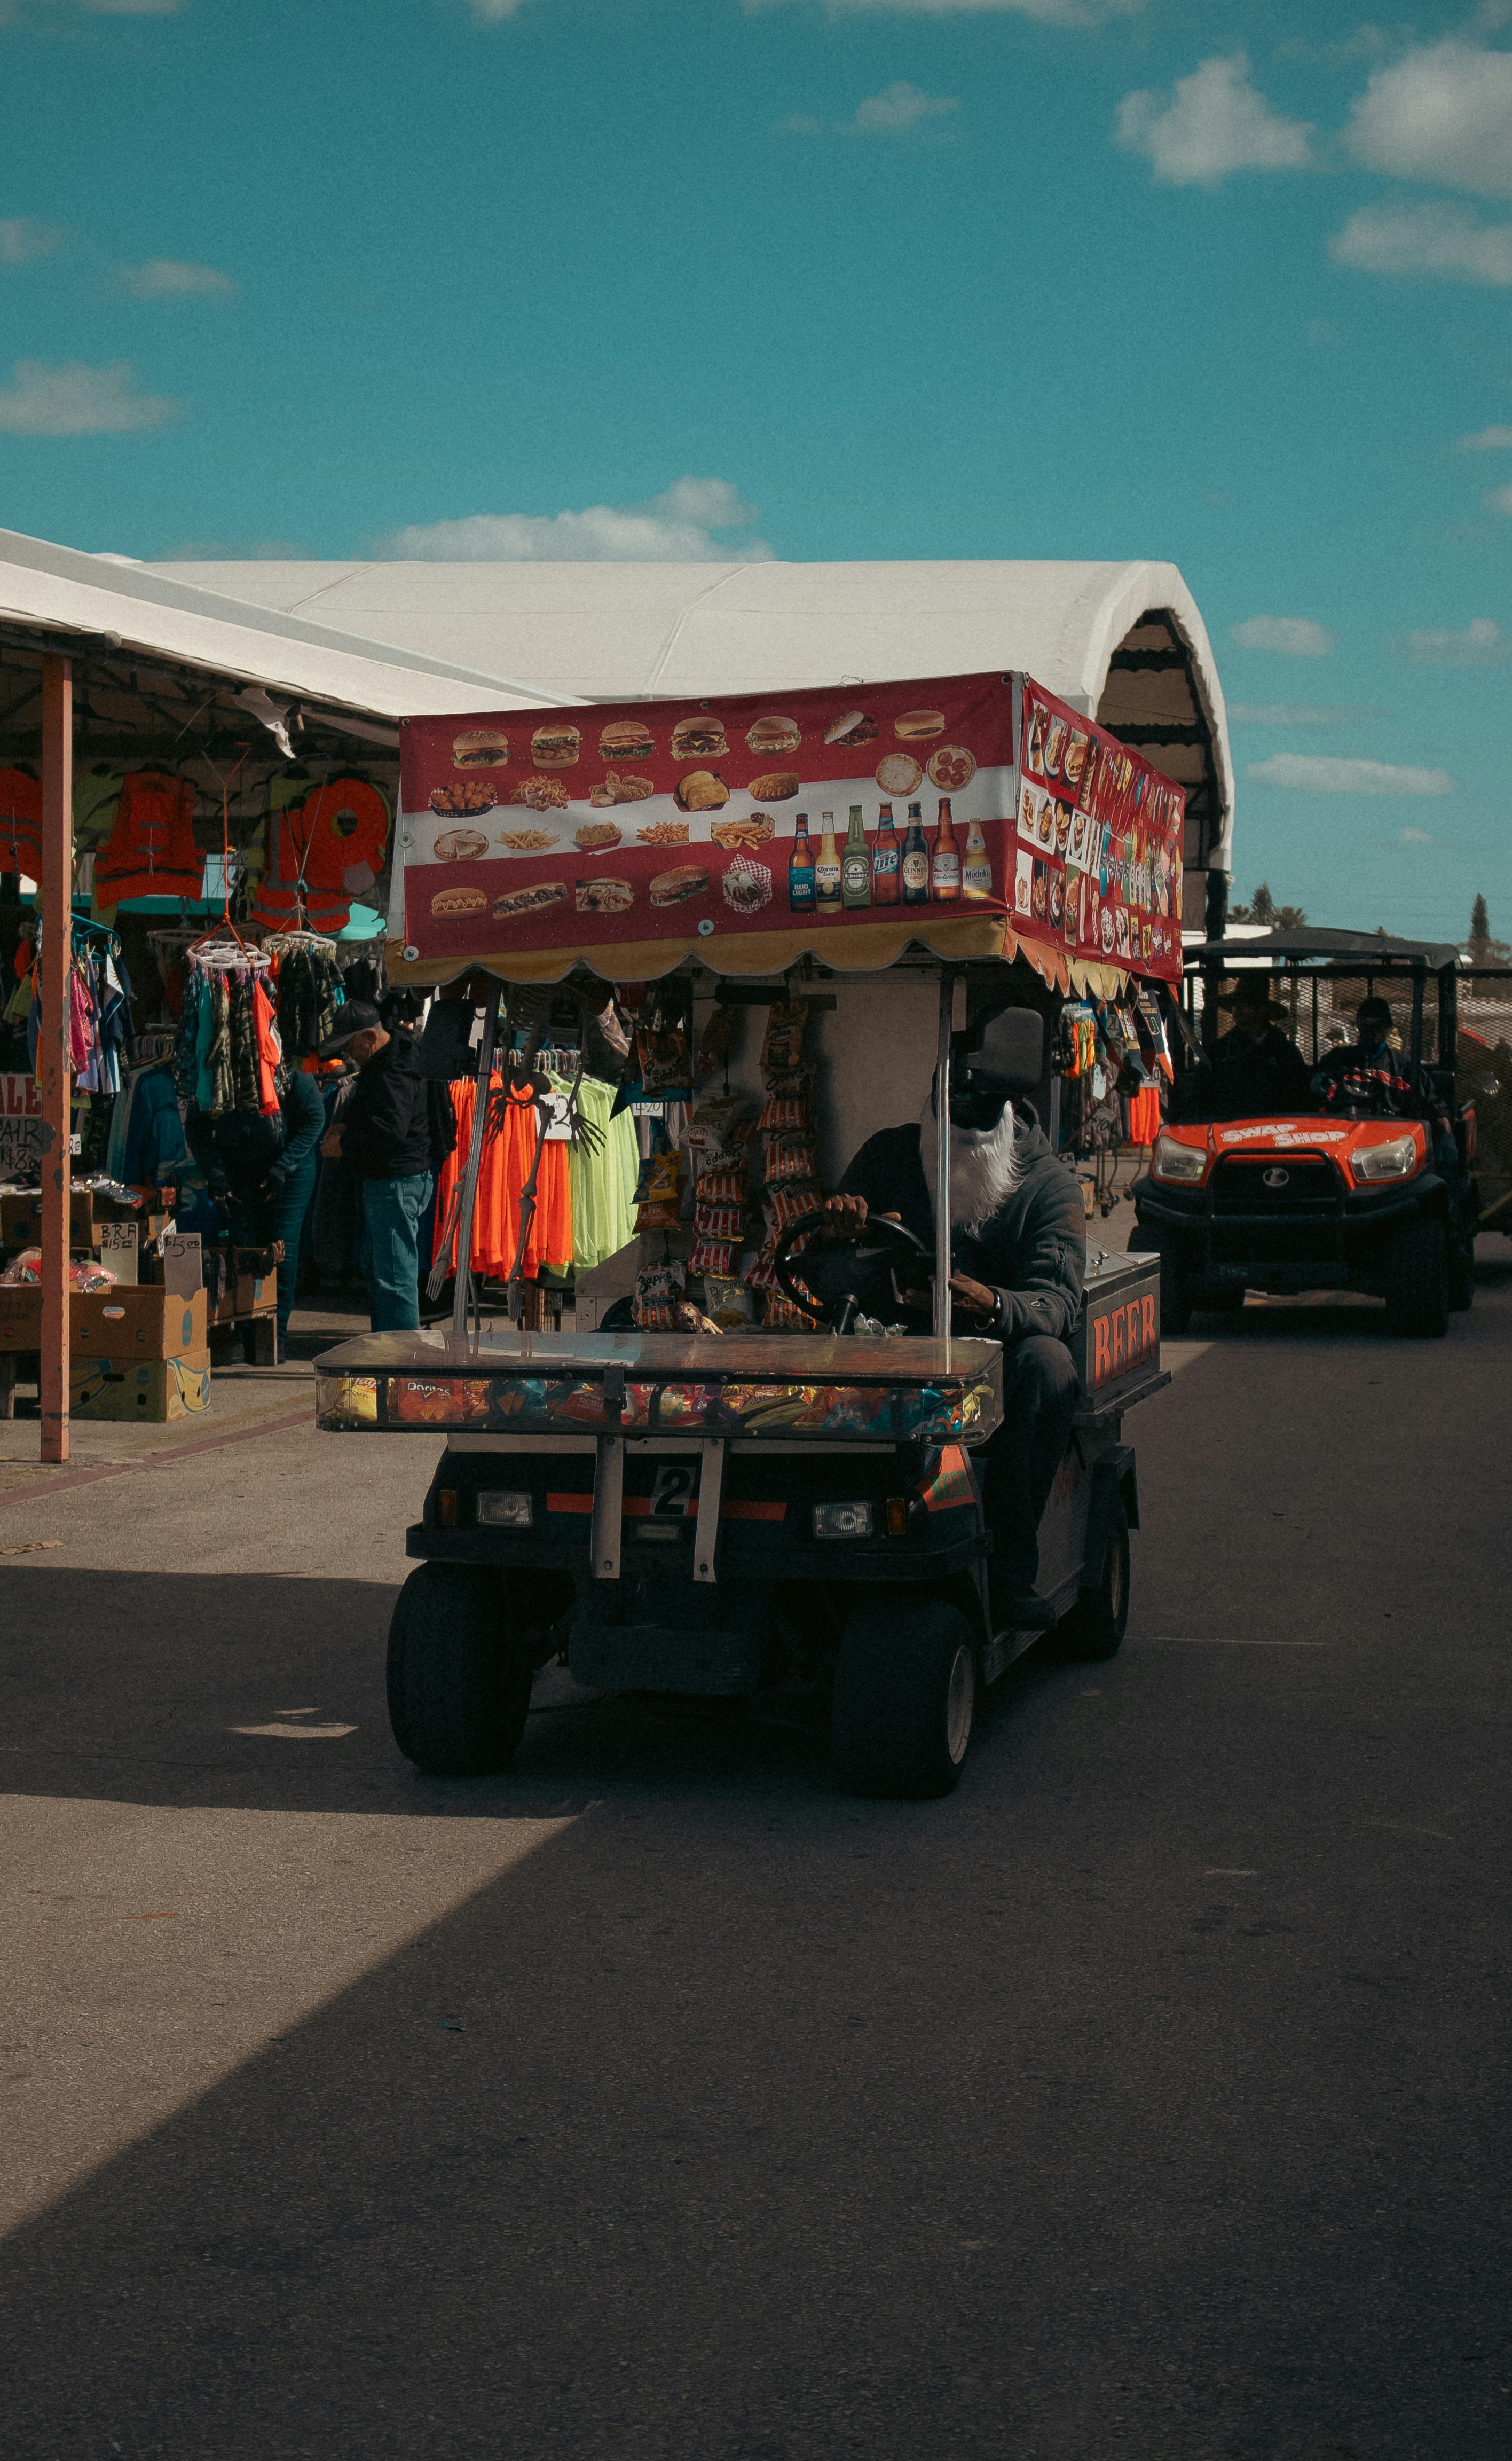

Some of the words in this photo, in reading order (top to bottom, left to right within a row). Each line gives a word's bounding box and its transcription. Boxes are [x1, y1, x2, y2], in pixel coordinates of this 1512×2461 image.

[966, 869, 988, 880] Modelo
[0, 1076, 41, 1115] LE
[0, 1119, 43, 1143] AIR
[1273, 1131, 1349, 1147] SHOP
[101, 1225, 137, 1240] BRA
[1093, 1291, 1156, 1391] BEER
[407, 1382, 450, 1394] Doritos
[579, 1397, 604, 1410] CHEDDAR
[655, 1468, 691, 1516] 2
